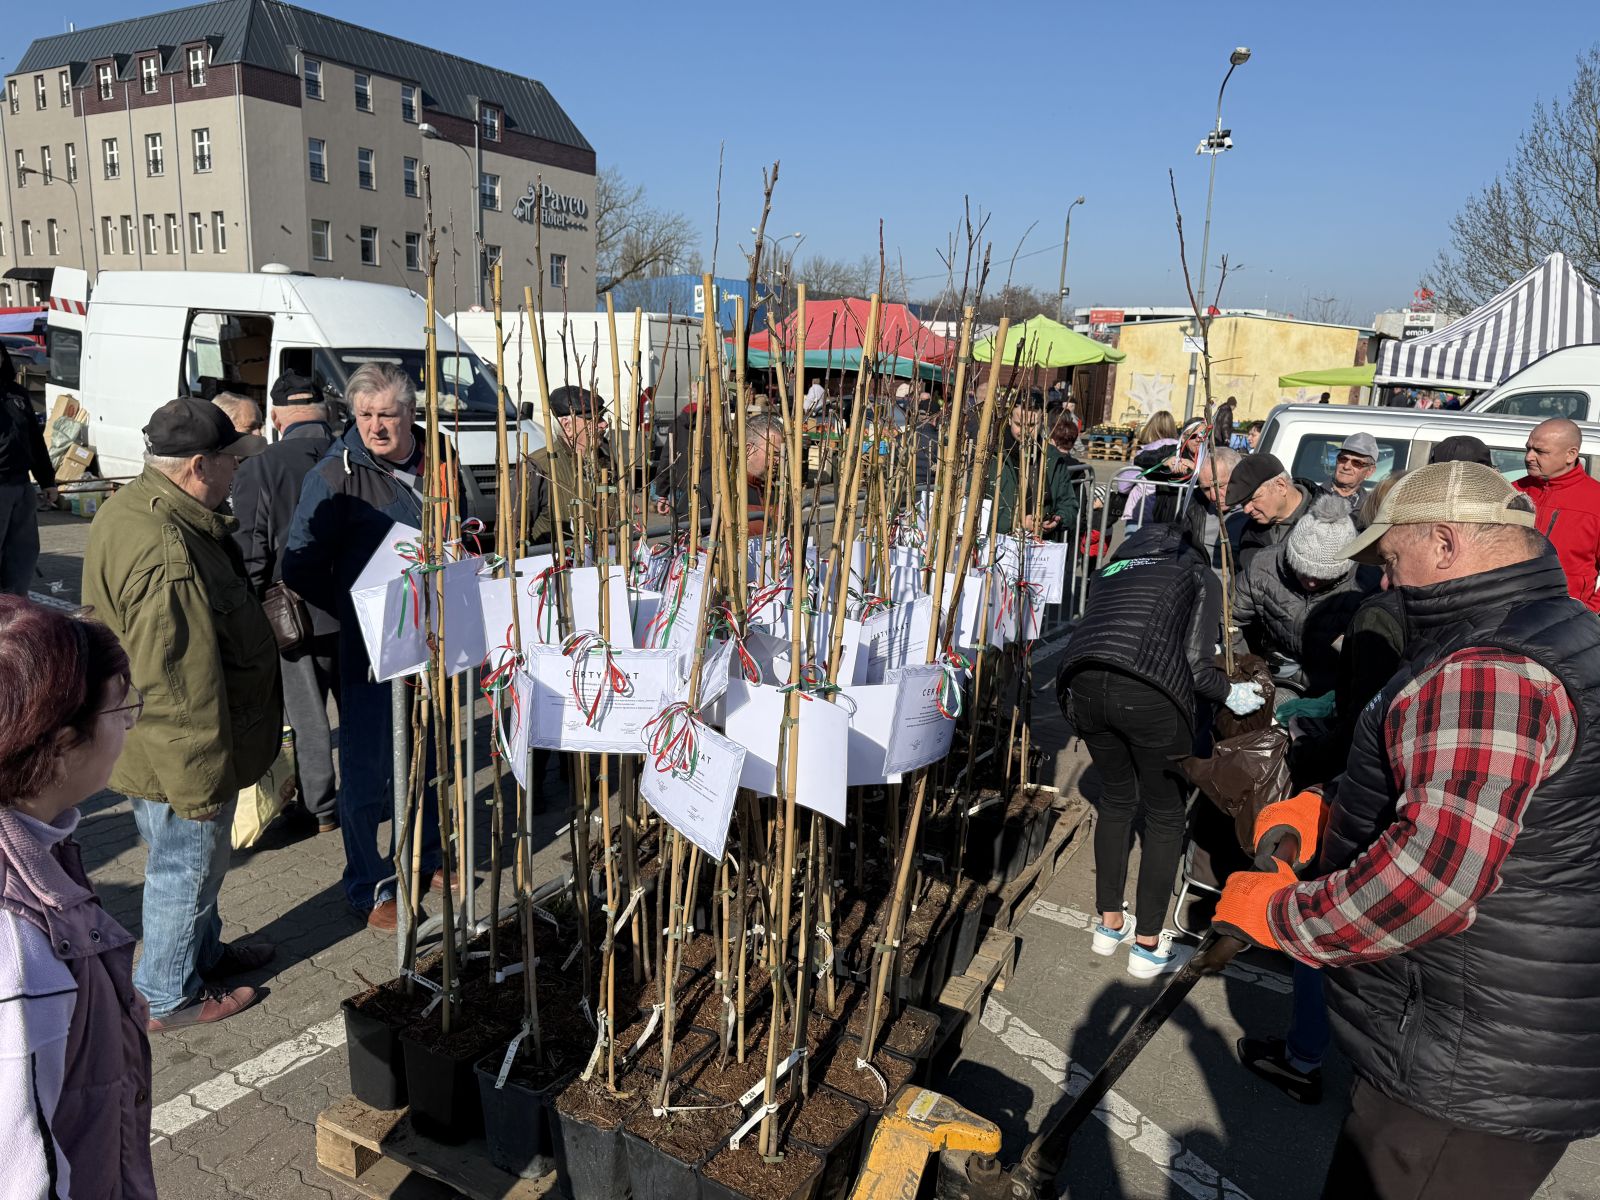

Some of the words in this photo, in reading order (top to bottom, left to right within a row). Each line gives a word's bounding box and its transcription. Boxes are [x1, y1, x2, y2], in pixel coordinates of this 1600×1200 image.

[541, 184, 585, 215] Pavco
[541, 209, 566, 226] Hotel
[565, 668, 640, 681] CERTYAT
